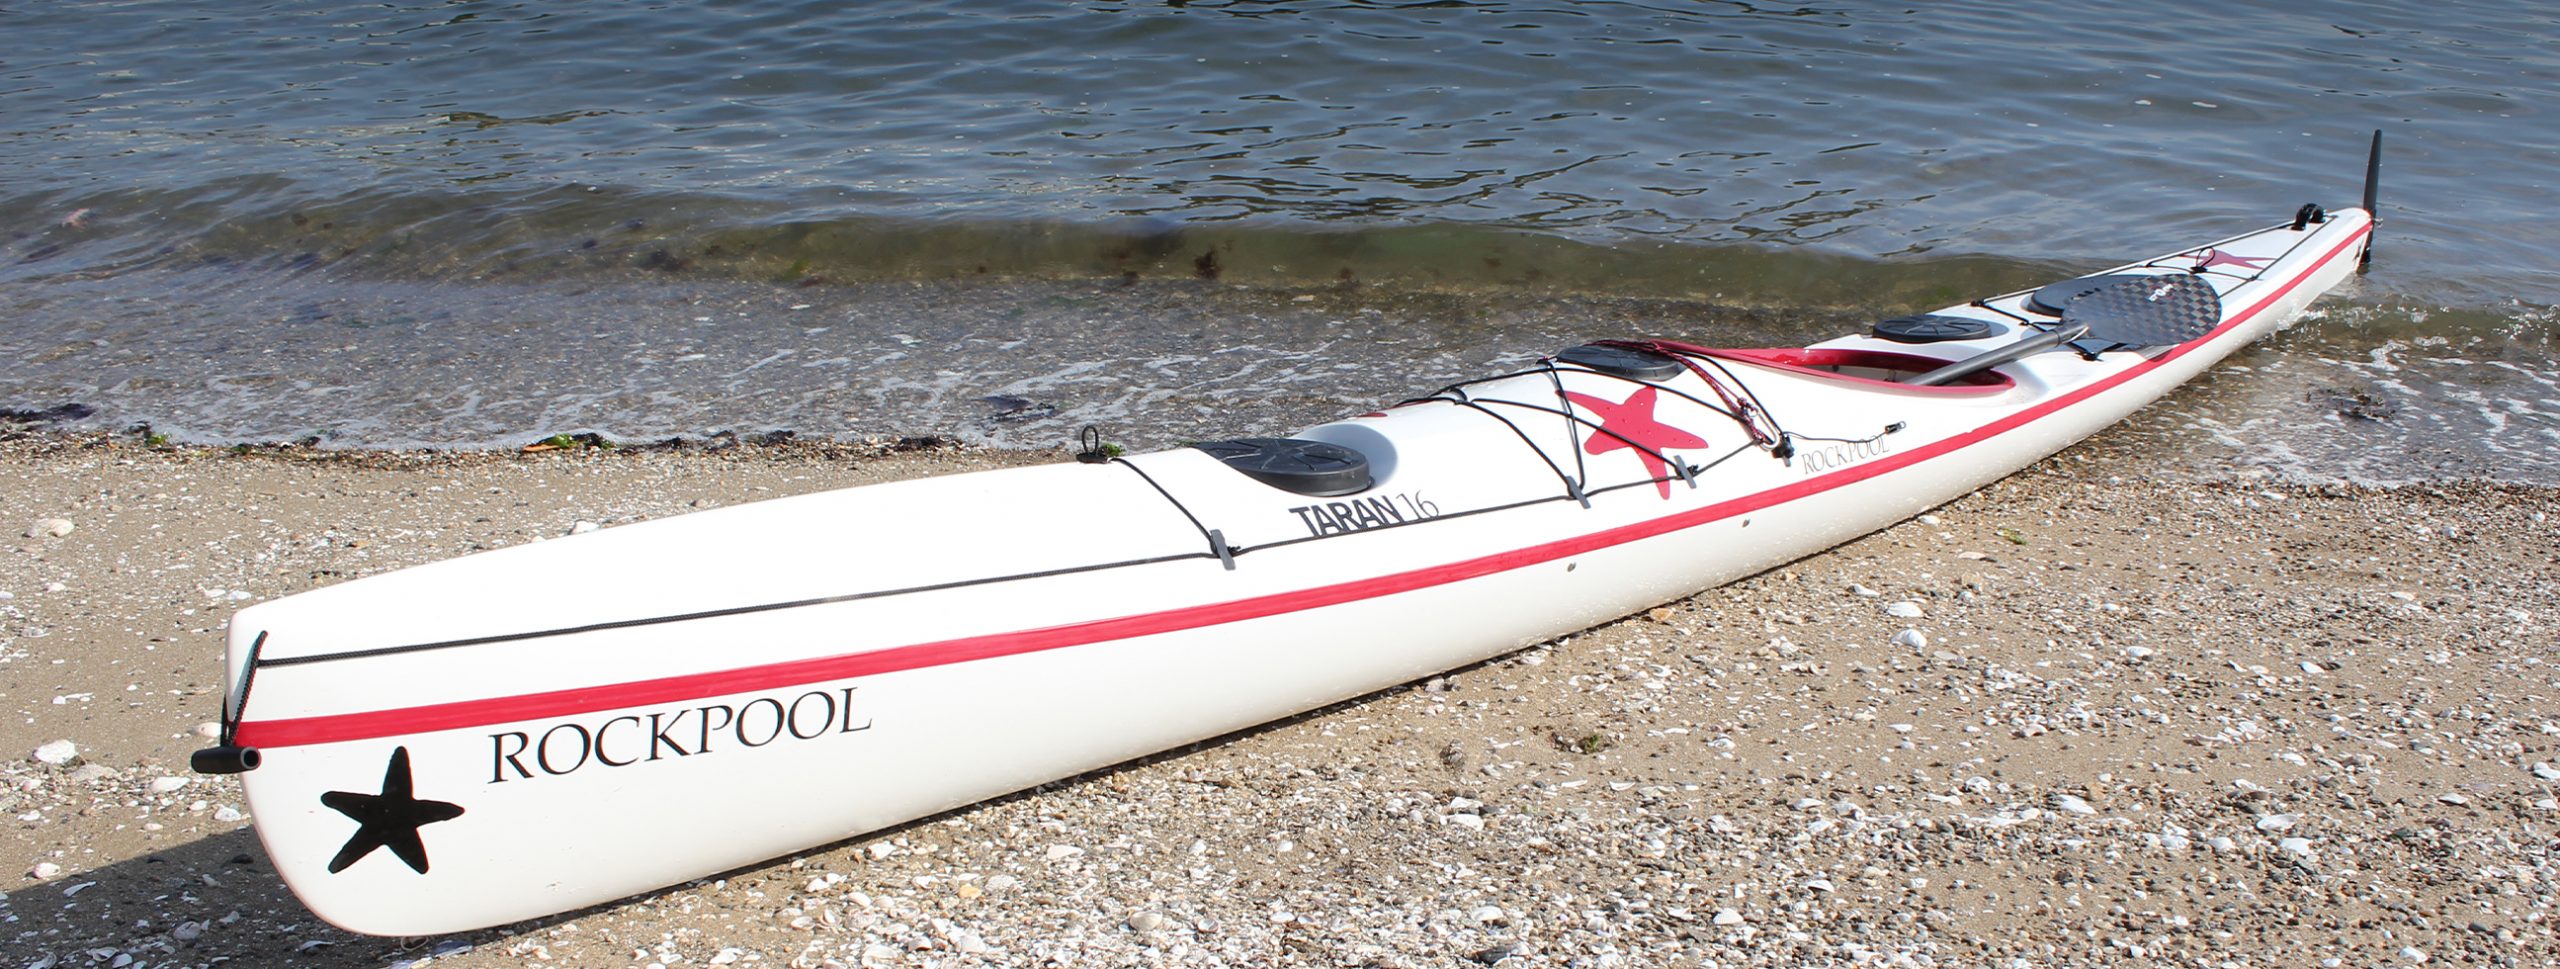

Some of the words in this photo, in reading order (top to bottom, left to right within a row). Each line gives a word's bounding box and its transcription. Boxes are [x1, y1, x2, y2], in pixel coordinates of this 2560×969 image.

[1802, 434, 1890, 475] ROCKPOOL
[1288, 494, 1408, 538] TARAN
[1396, 489, 1440, 520] 16
[487, 686, 873, 784] ROCKPOOL
